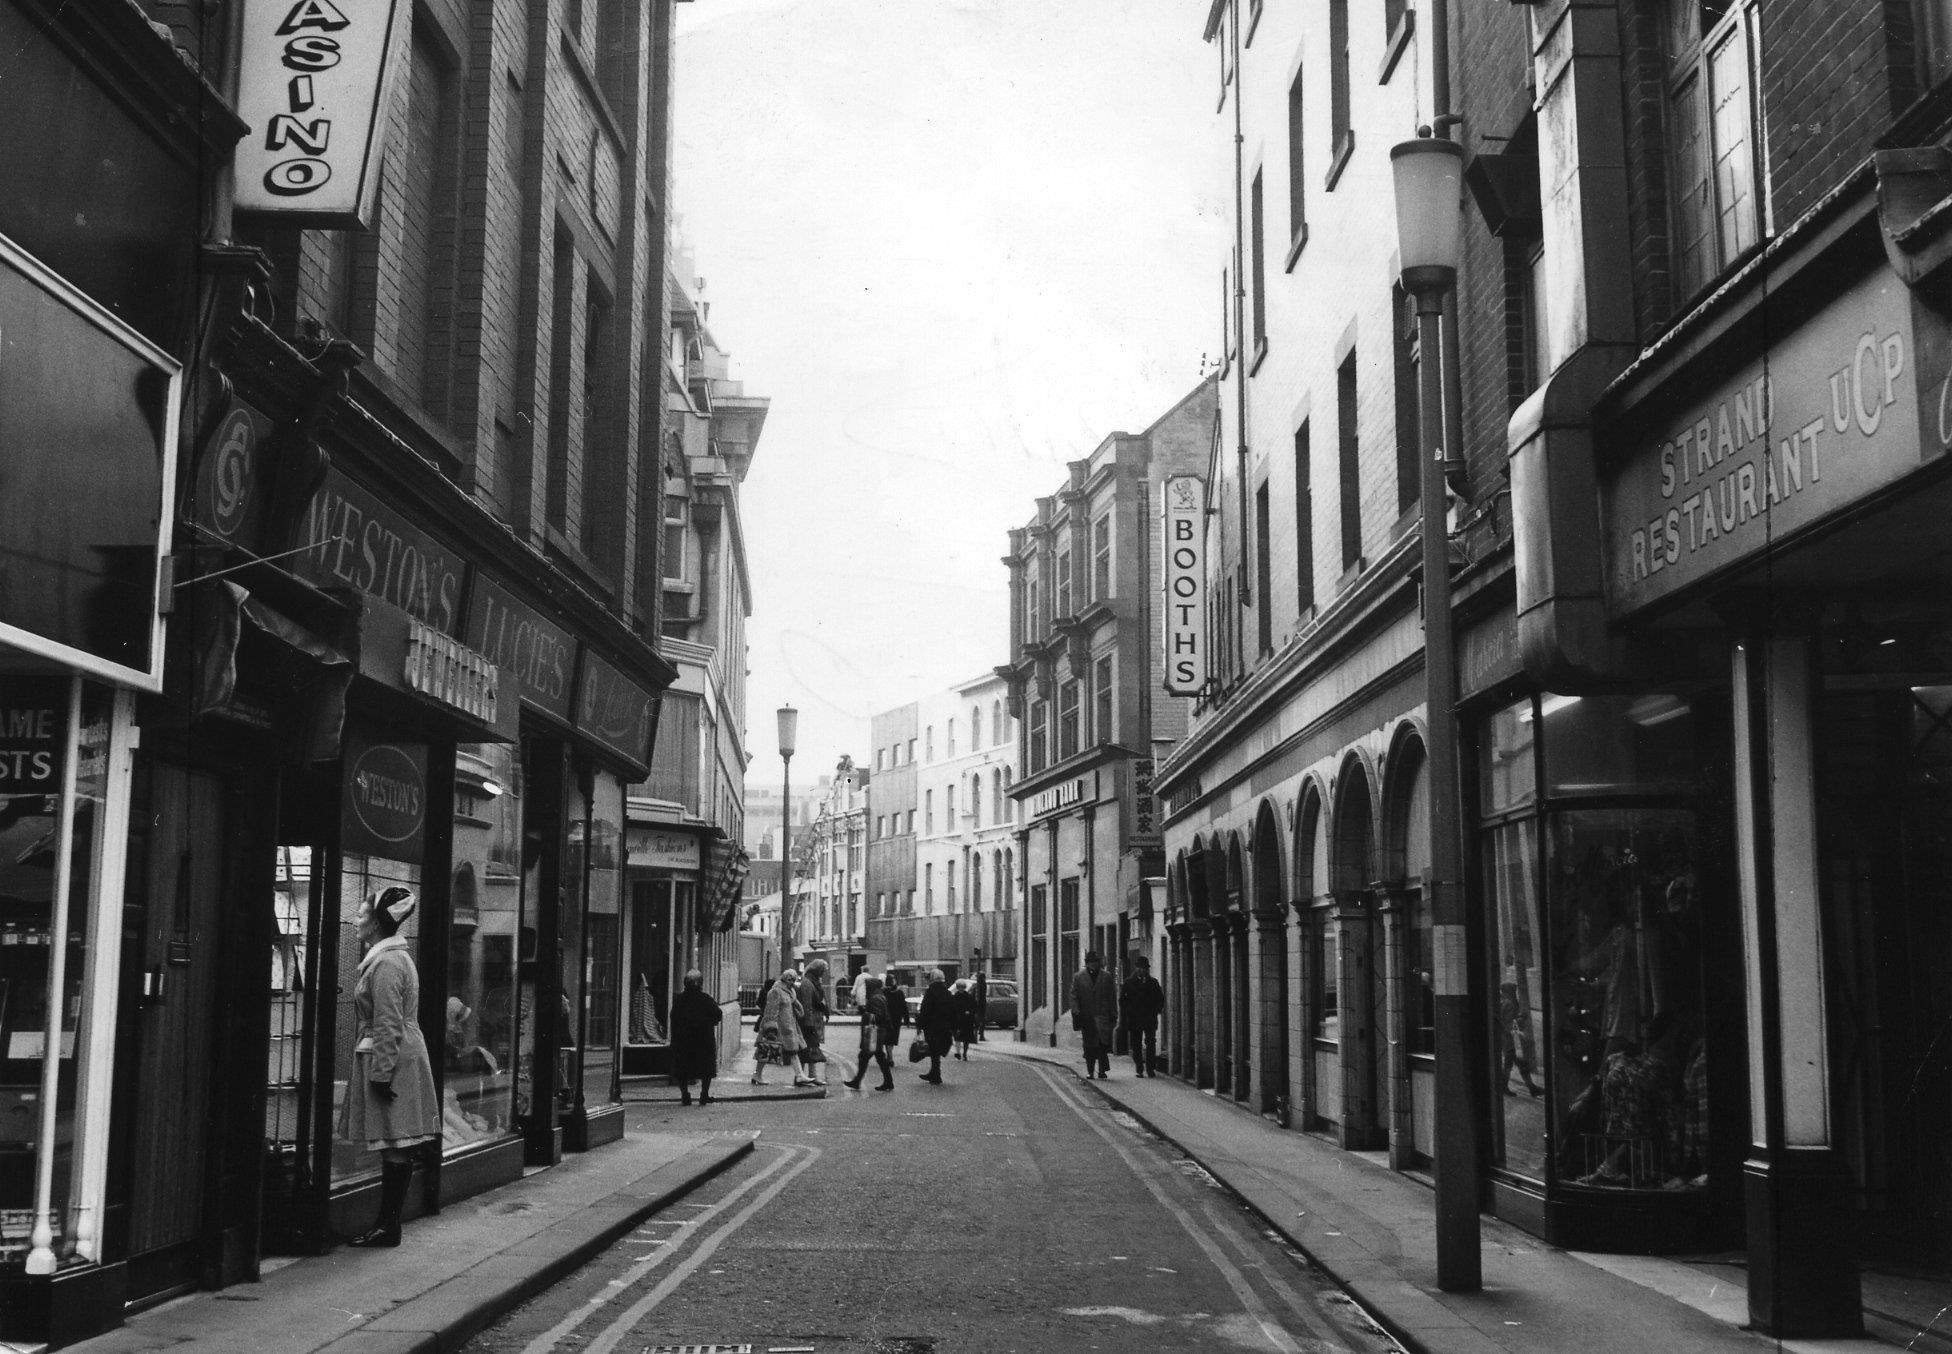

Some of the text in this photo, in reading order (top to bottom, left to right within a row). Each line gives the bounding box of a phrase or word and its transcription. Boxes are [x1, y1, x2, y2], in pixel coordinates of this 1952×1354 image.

[1660, 370, 1776, 500] STRAND
[1829, 330, 1905, 438] UCP
[309, 490, 457, 636] WESTON'S
[1631, 415, 1827, 586] RESTAURANT
[480, 595, 568, 700] LUCIE'S
[1173, 518, 1198, 684] BOOTHS
[357, 771, 419, 817] WESTON'S
